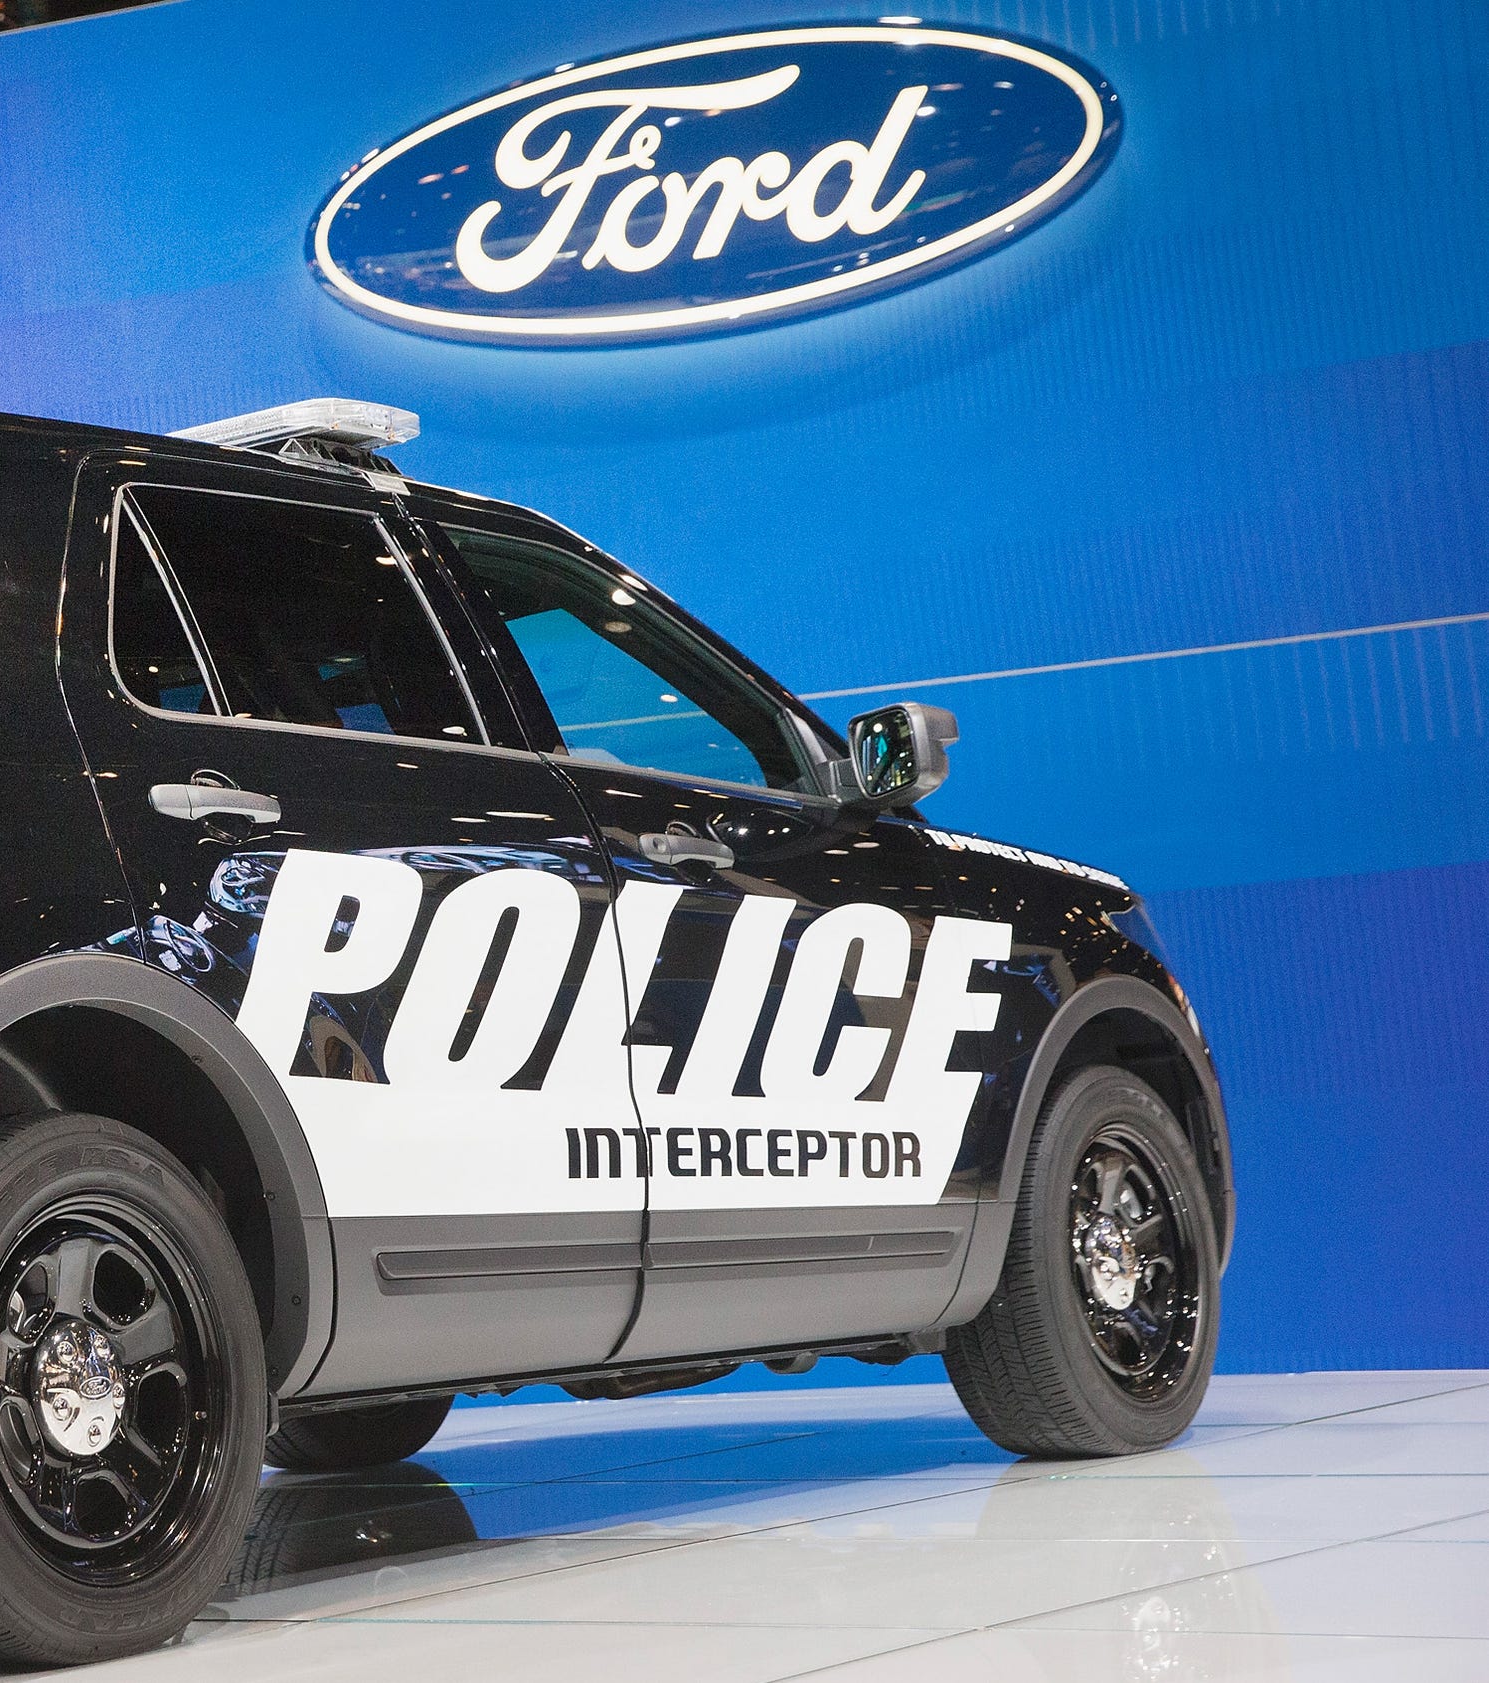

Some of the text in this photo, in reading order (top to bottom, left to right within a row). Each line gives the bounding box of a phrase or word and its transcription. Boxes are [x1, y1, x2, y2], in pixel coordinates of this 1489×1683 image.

[455, 64, 927, 294] Ford
[235, 849, 1013, 1101] POLICE
[567, 1127, 921, 1179] INTERCEPTOR
